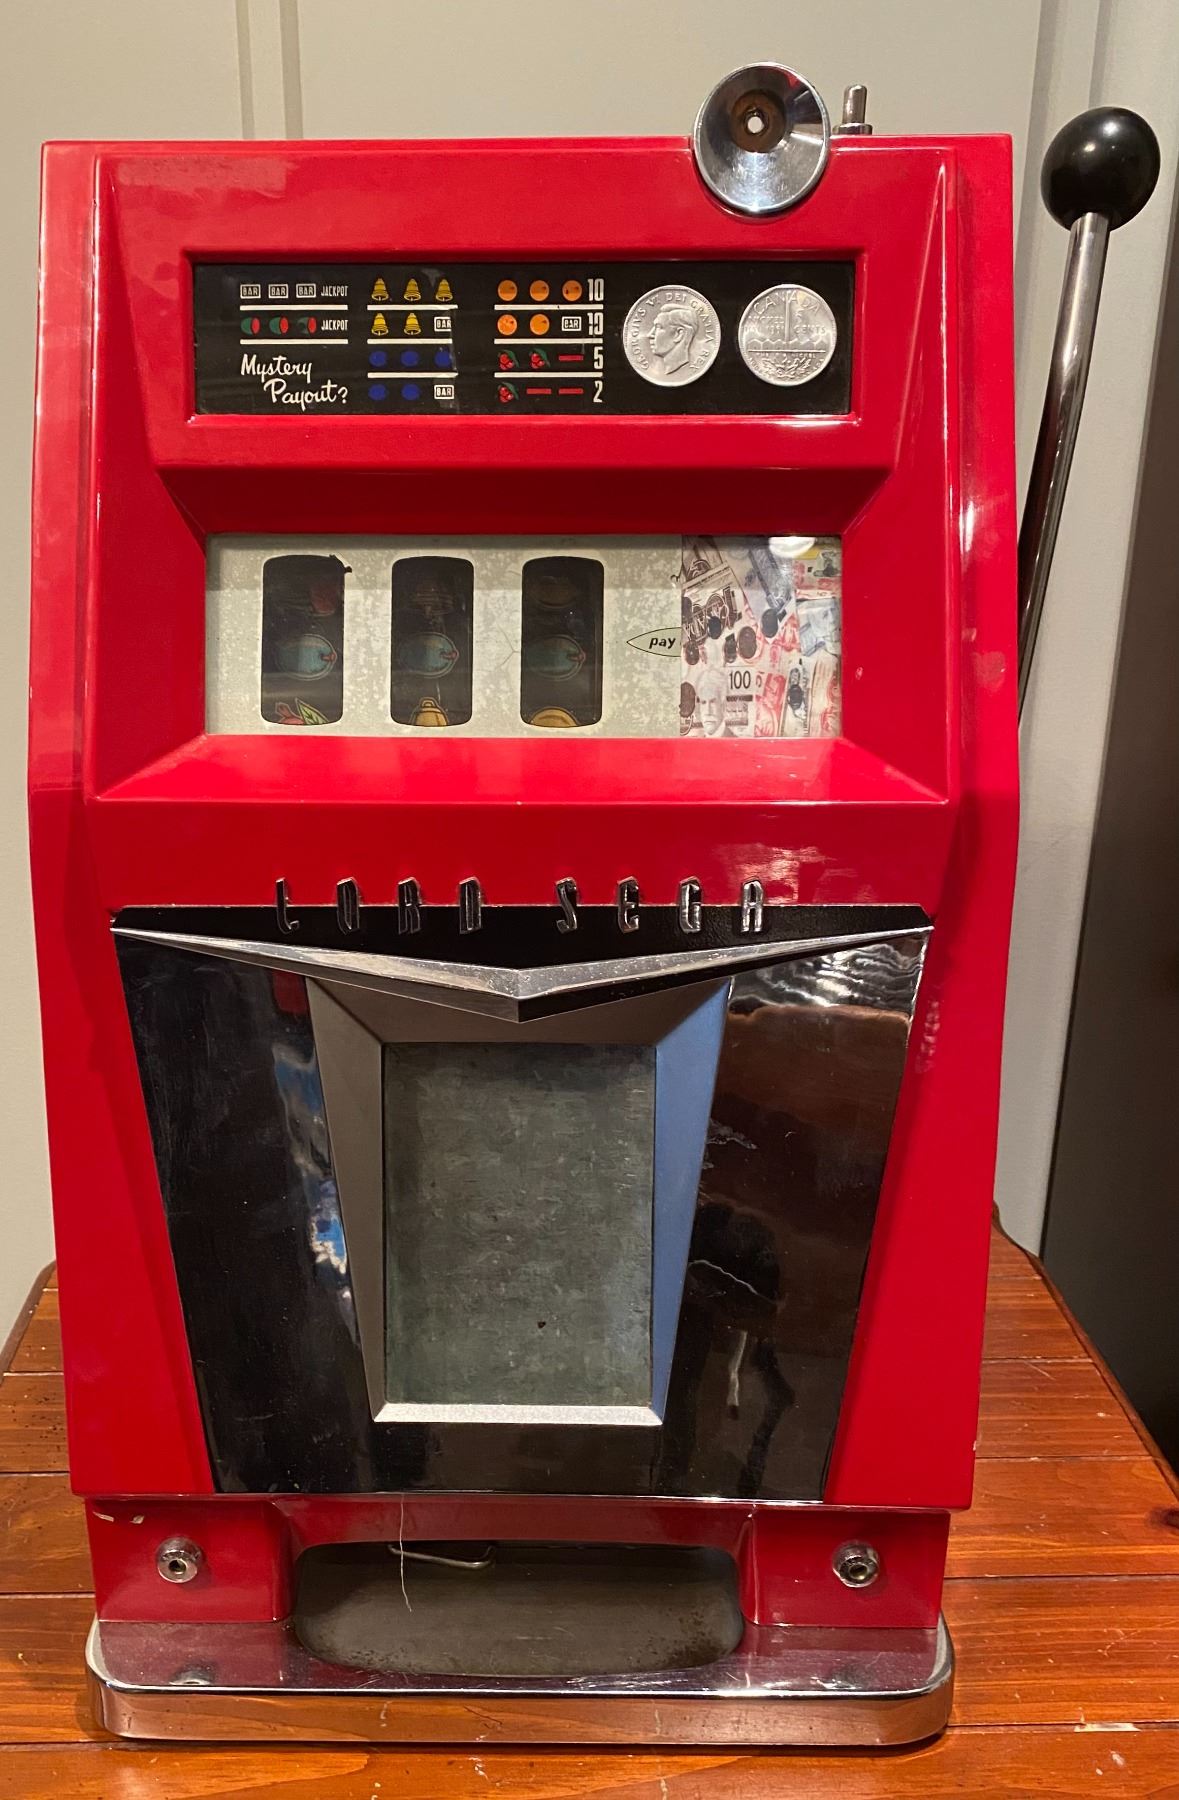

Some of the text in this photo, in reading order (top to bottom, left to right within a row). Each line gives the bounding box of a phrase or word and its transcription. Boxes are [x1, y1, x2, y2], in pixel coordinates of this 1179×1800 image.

[242, 285, 348, 297] BAR BAR BAR JACKPOT
[587, 278, 604, 301] 10
[320, 319, 348, 331] JACKPOT
[435, 319, 452, 329] BAR
[564, 319, 580, 329] BAR
[593, 346, 604, 369] 5
[240, 353, 313, 384] Mystery
[263, 378, 348, 410] Payout?
[436, 387, 453, 397] BAR
[593, 380, 604, 402] 2
[649, 637, 676, 649] pay
[729, 670, 751, 689] 100
[275, 876, 763, 935] LORD SEGA
